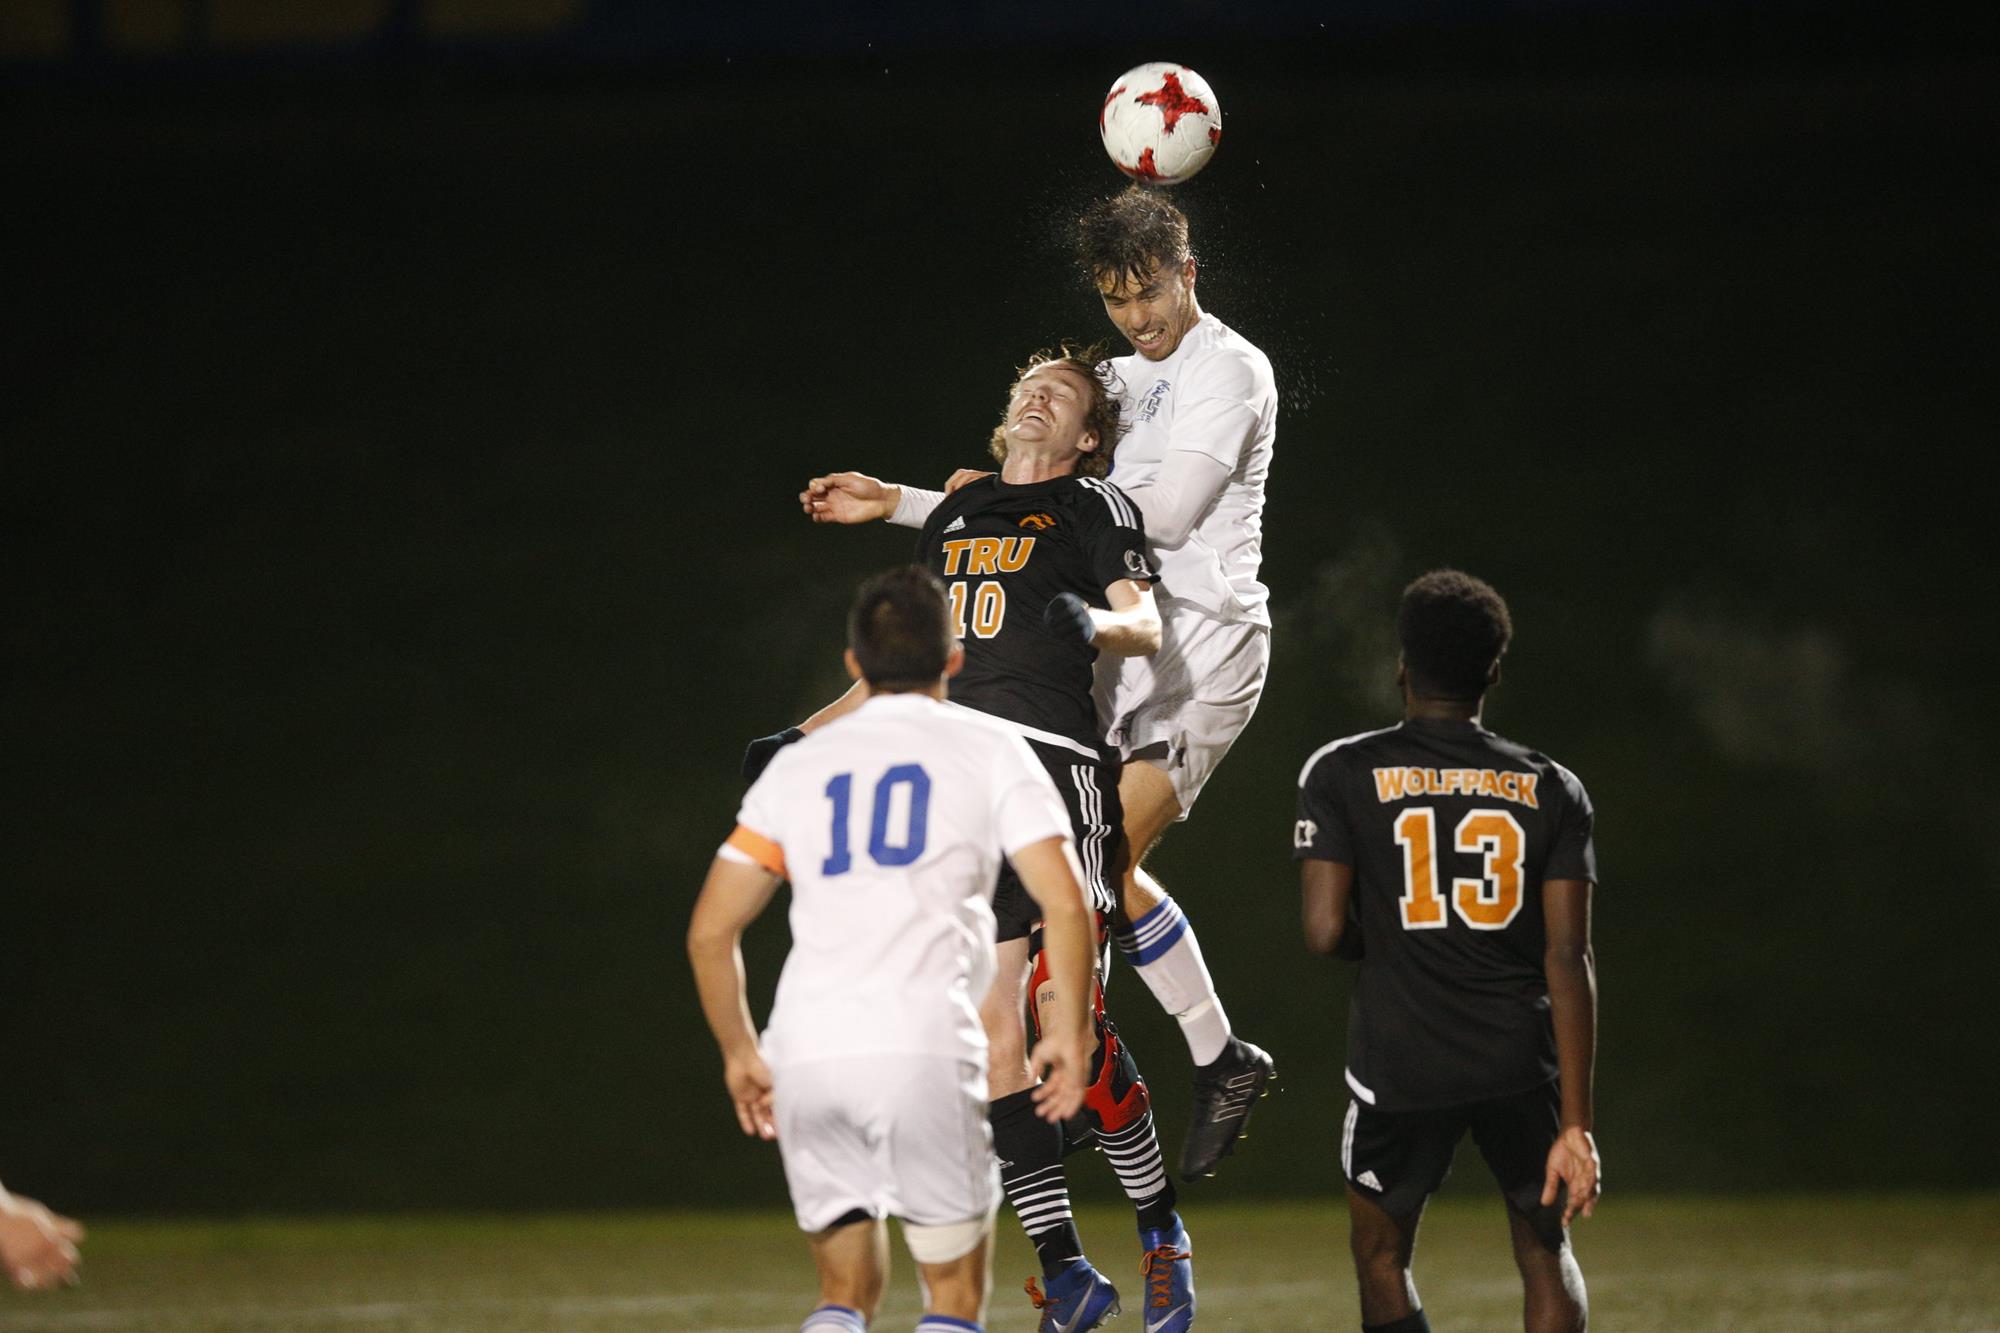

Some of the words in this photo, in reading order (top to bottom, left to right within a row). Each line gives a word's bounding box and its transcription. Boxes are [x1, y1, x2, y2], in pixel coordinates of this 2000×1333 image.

[942, 537, 1036, 576] TRU
[949, 580, 1006, 639] 10
[1372, 766, 1539, 809] WOLFPACK
[822, 763, 931, 876] 10
[1393, 806, 1526, 931] 13
